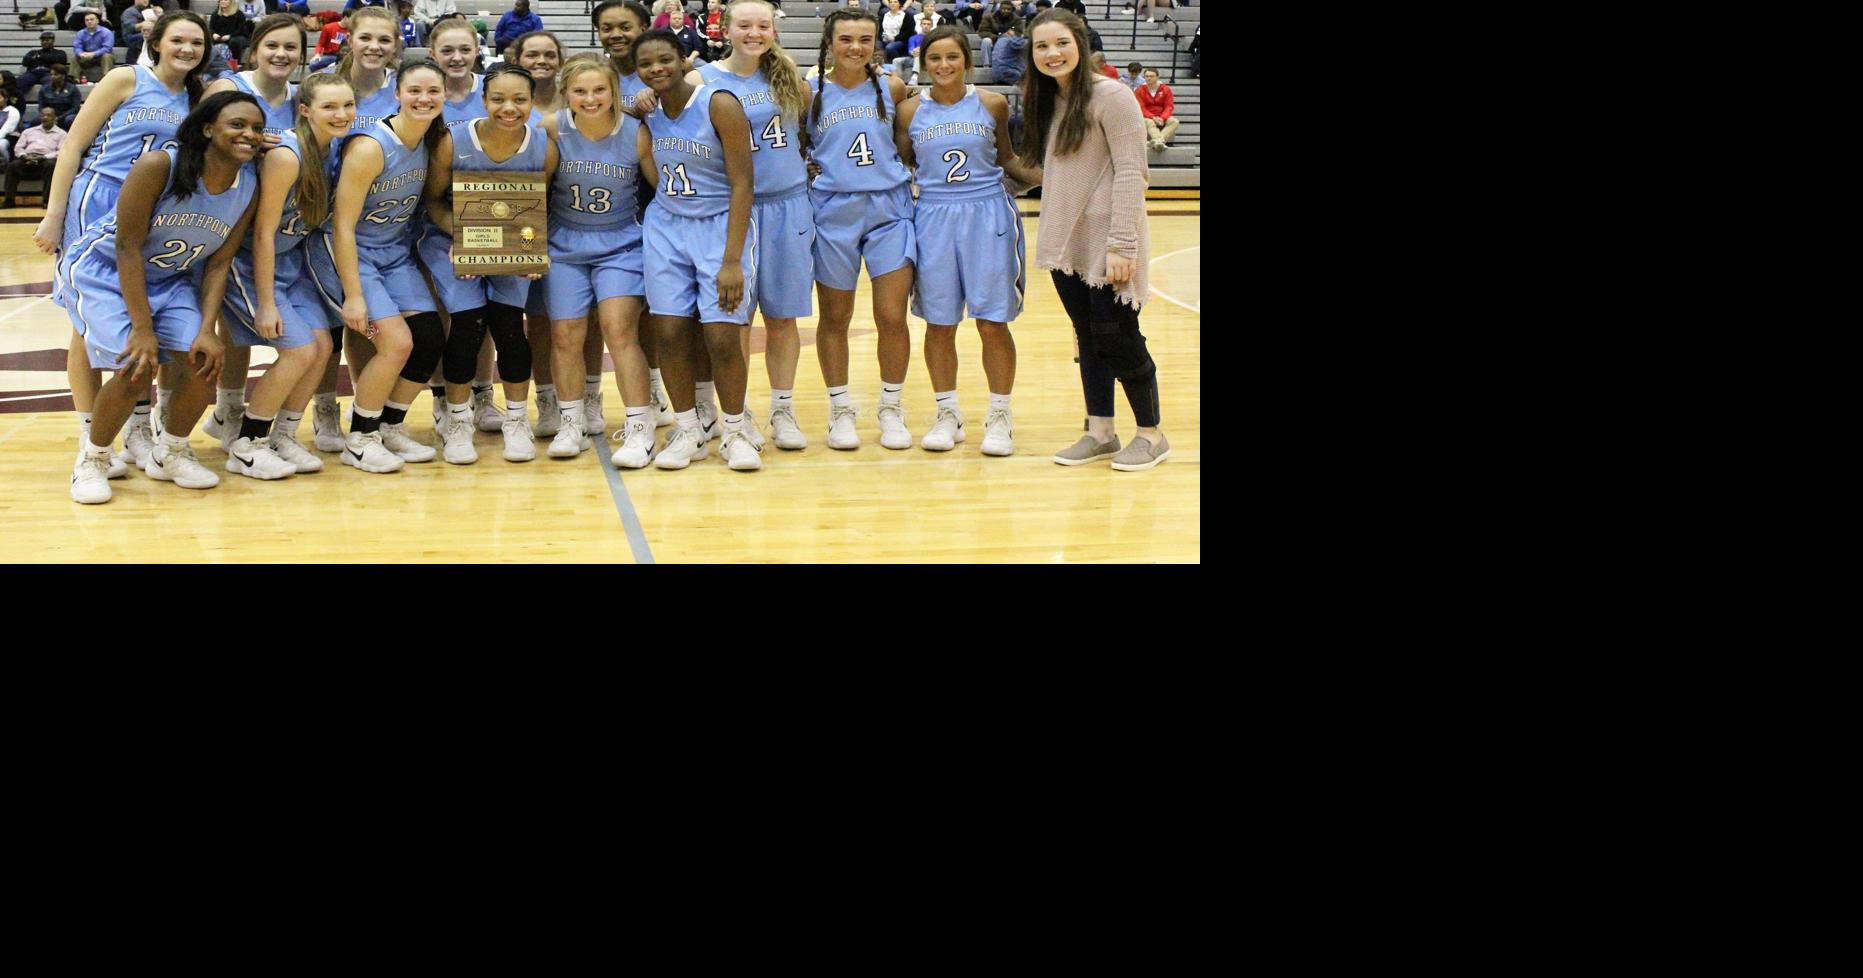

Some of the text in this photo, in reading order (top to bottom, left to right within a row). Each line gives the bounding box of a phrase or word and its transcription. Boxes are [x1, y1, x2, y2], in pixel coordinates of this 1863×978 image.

[847, 132, 874, 167] 4
[661, 163, 697, 196] 11
[943, 148, 970, 183] 2
[463, 183, 536, 191] REGIONAL
[569, 184, 612, 214] 13
[364, 195, 418, 225] 22
[148, 239, 206, 271] 21
[458, 255, 543, 264] CHAMPIONS
